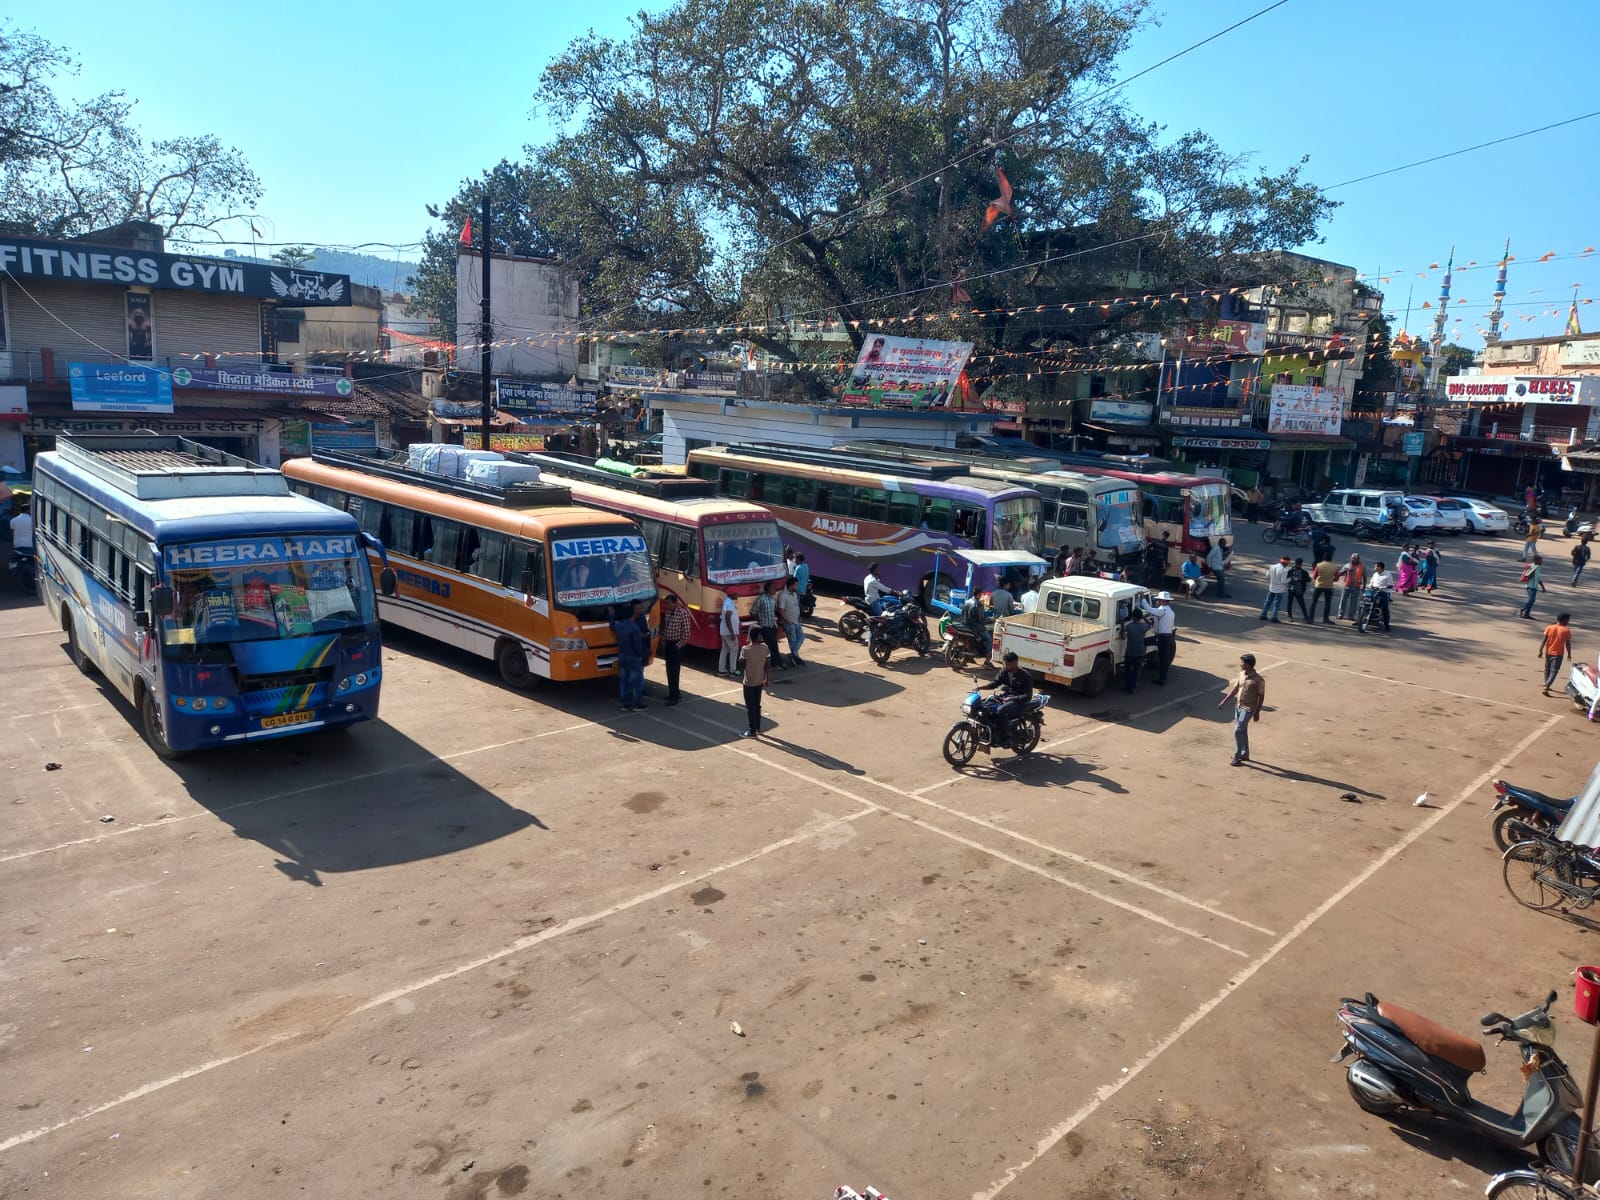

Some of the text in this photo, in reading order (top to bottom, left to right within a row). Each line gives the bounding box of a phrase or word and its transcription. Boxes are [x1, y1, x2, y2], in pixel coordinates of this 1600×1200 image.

[0, 245, 245, 292] FITNESS GYM
[96, 369, 146, 382] Leeford
[1466, 384, 1508, 396] COLLECTION
[812, 516, 858, 535] ANJANI
[171, 539, 353, 564] HEERA HARI
[554, 536, 645, 558] NEERAJ
[397, 567, 450, 598] NEERAJ
